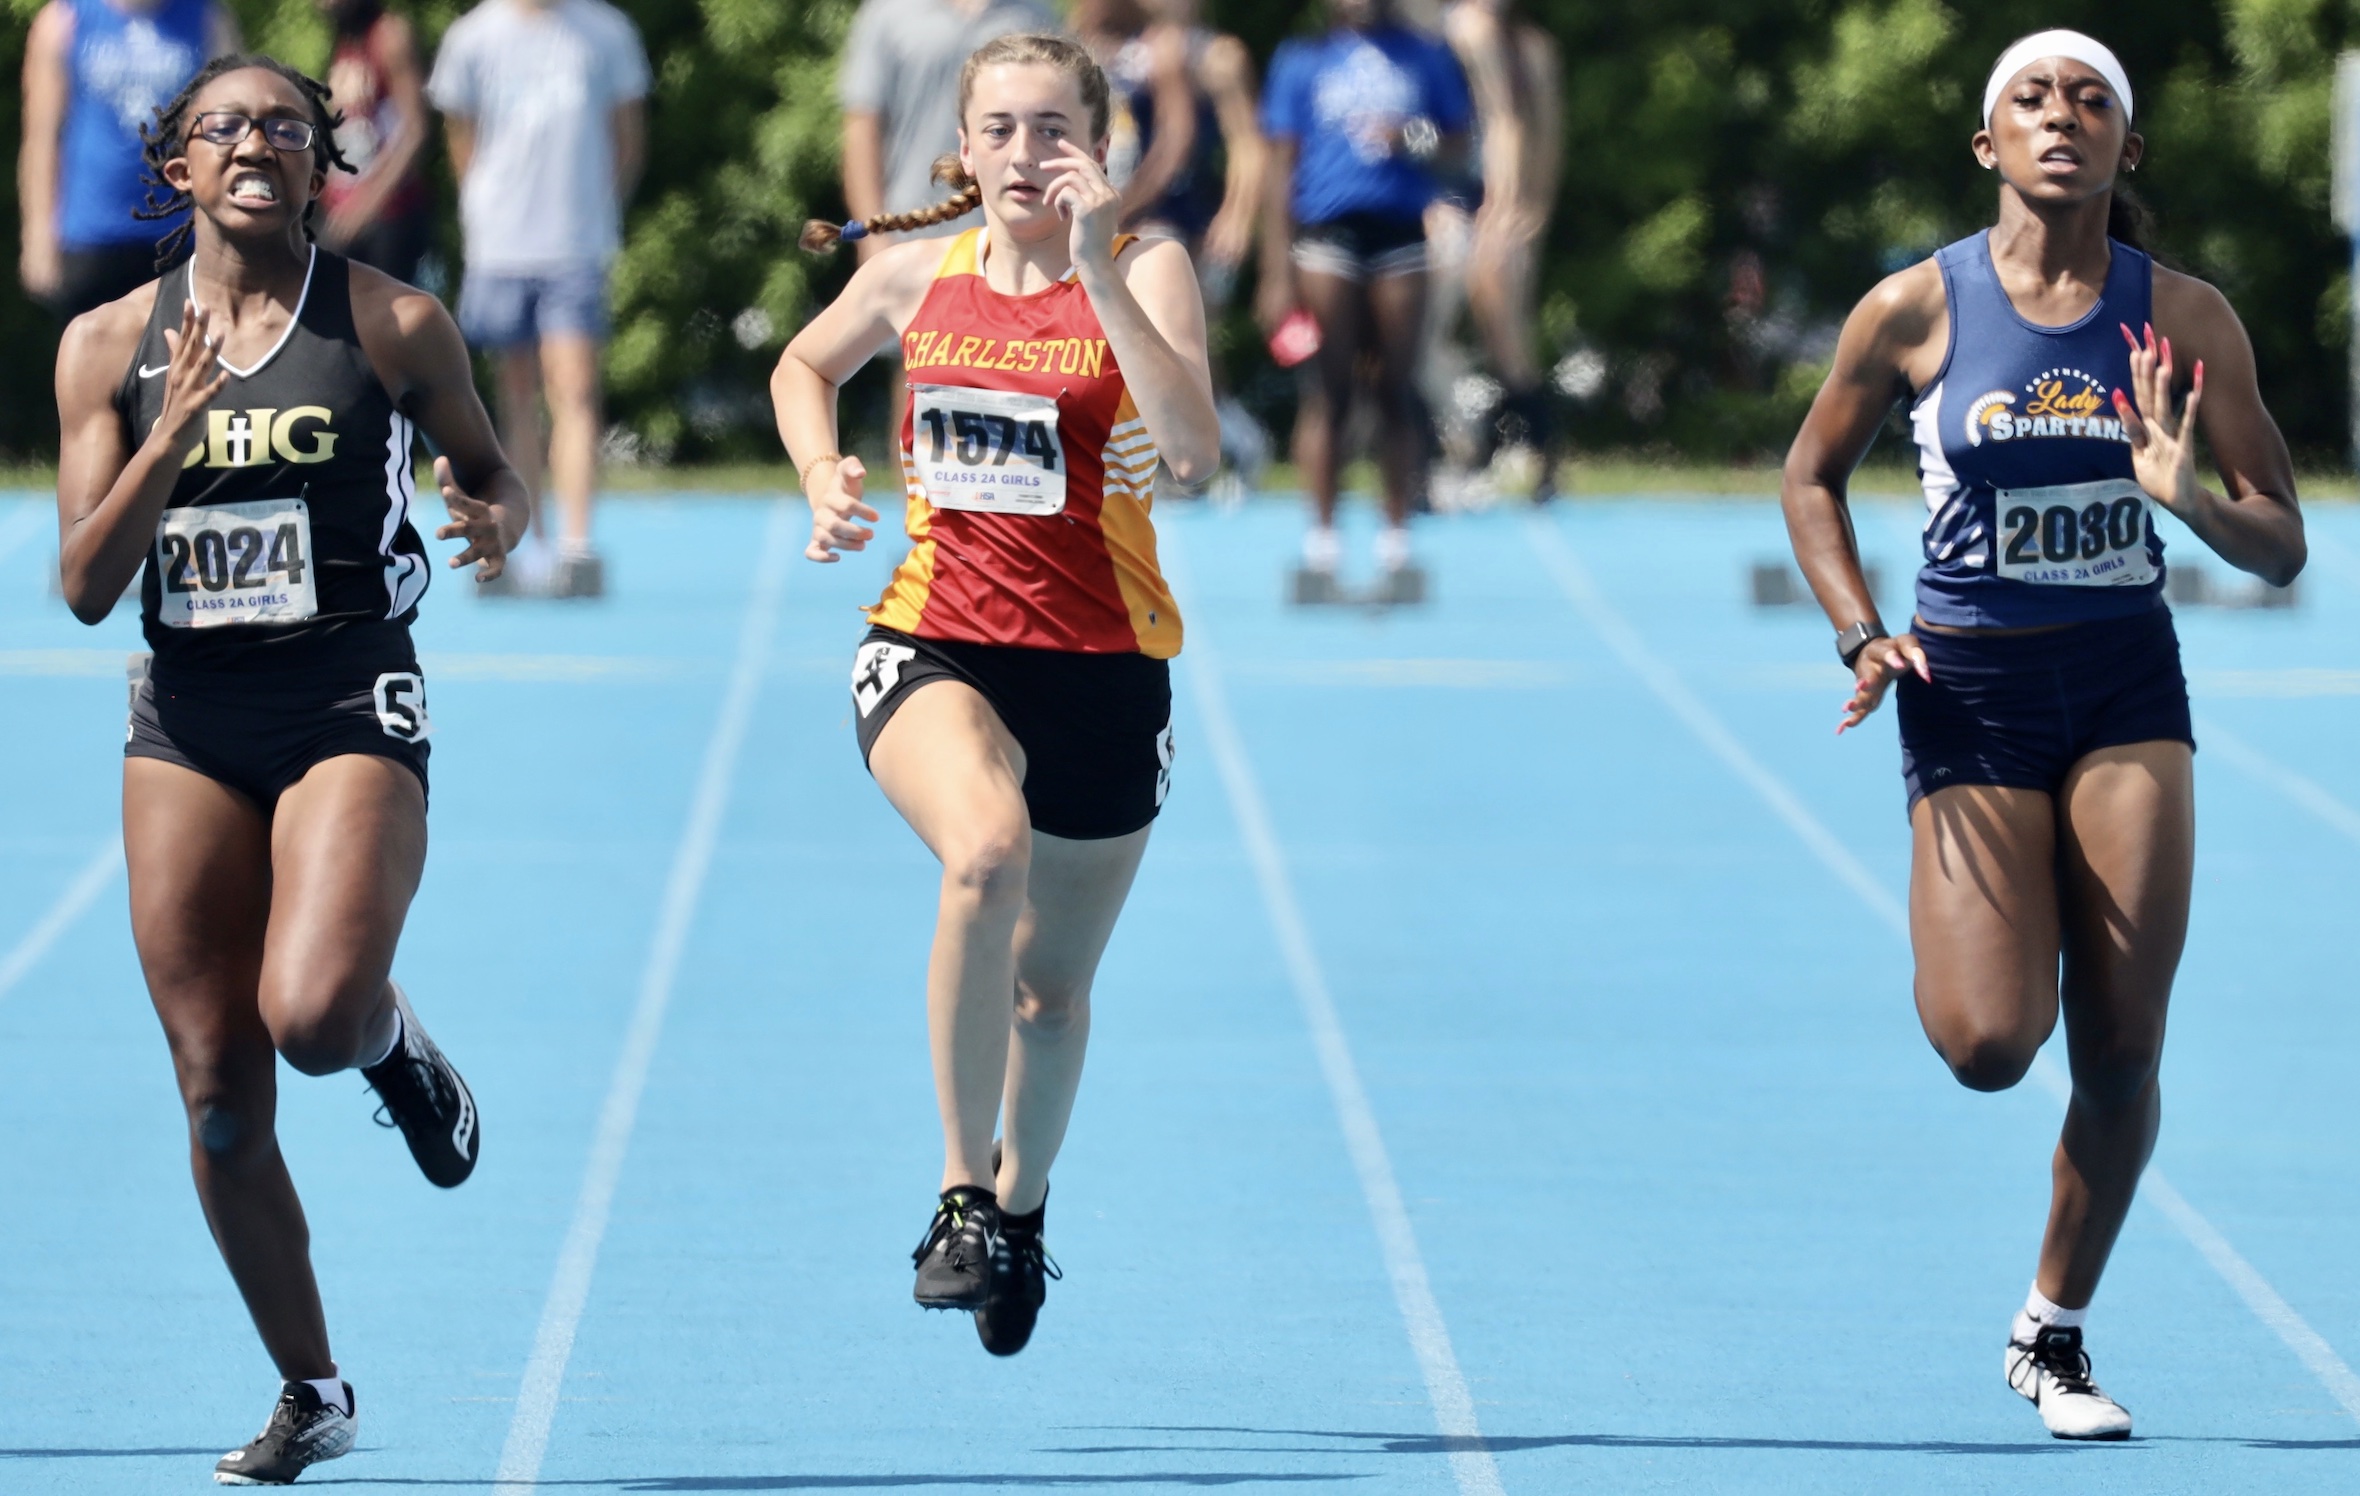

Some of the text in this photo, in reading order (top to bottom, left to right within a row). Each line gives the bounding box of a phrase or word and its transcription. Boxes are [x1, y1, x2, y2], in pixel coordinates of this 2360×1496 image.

[904, 330, 1107, 378] CHARLESTON
[2025, 367, 2107, 393] SOUTHEAST
[2026, 380, 2105, 419] Lady
[152, 405, 339, 469] HG
[921, 407, 1057, 470] 1574
[934, 471, 1041, 487] CLASS 2A GIRLS
[2005, 496, 2142, 565] 2030
[161, 523, 305, 593] 2024
[2024, 556, 2125, 581] CLASS 2A GIRLS
[186, 593, 288, 611] CLASS 2A GIRLS
[384, 679, 420, 738] 5
